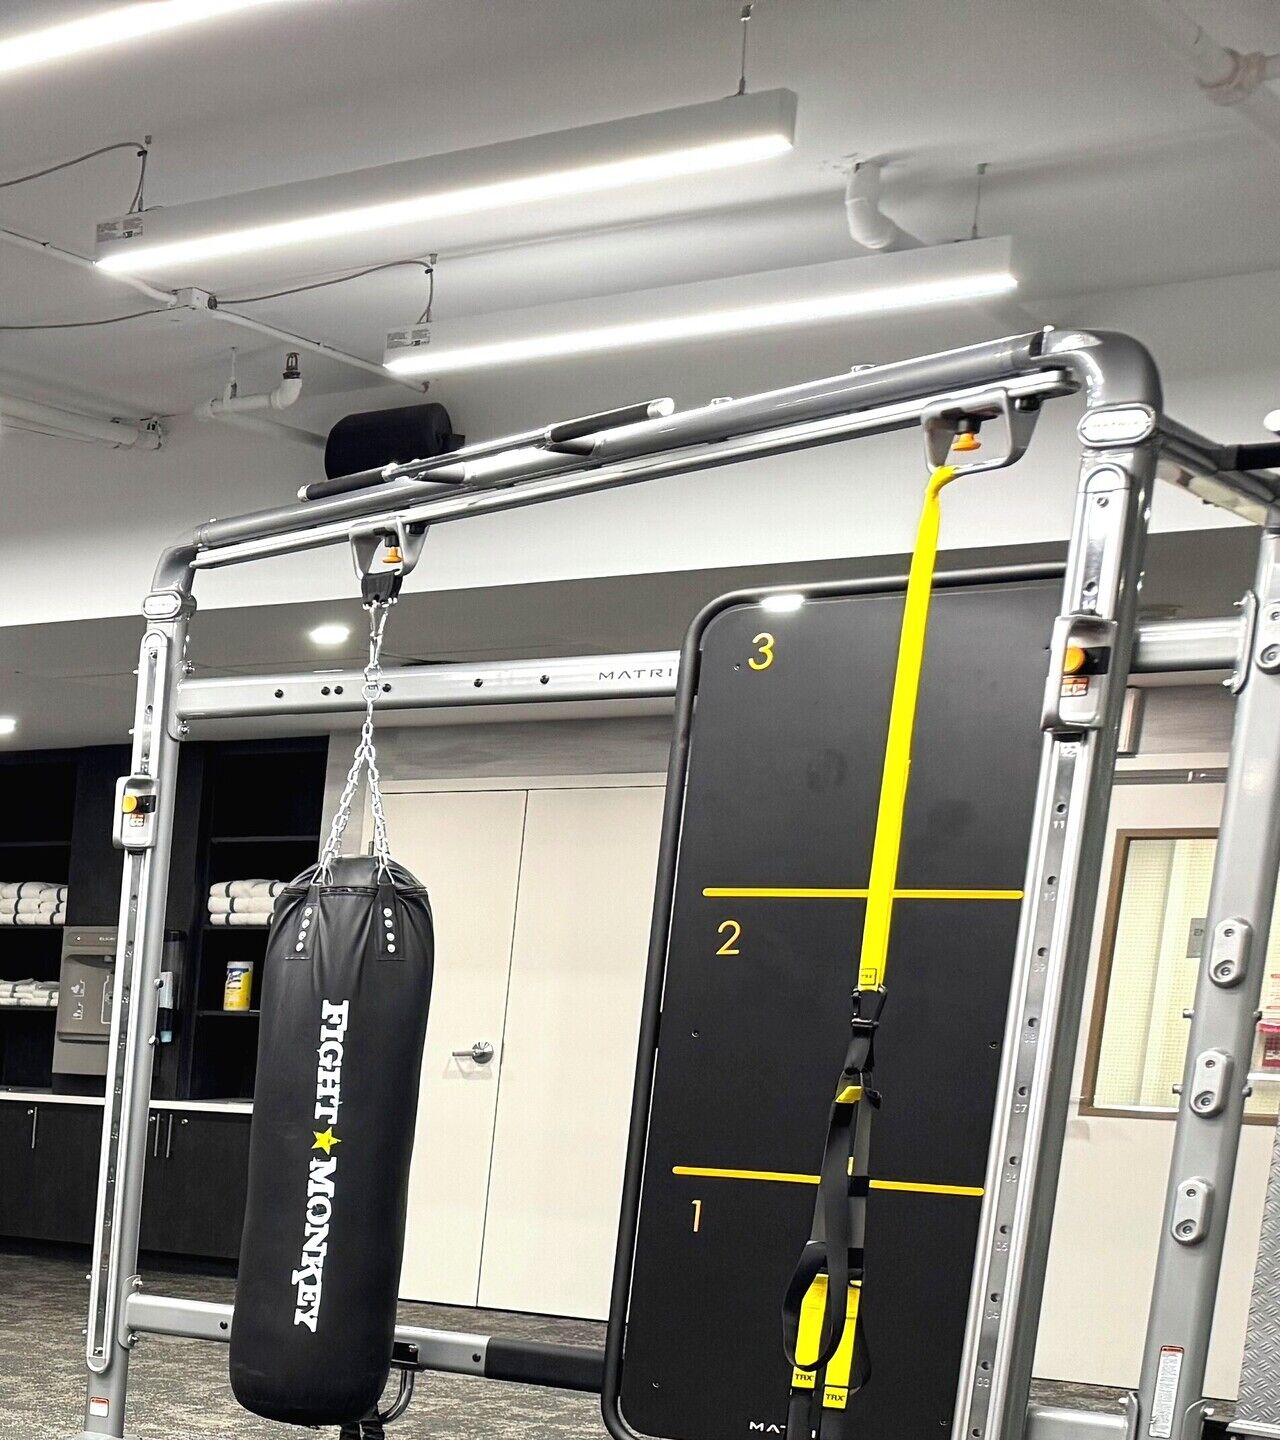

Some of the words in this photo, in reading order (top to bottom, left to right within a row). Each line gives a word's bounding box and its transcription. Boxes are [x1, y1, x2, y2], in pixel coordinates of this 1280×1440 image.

[747, 631, 775, 672] 3
[597, 668, 673, 681] MATRI
[714, 919, 742, 956] 2
[313, 999, 350, 1125] FIGHT
[690, 1199, 701, 1233] 1
[291, 1155, 338, 1333] MONKEY
[794, 1373, 814, 1382] TRX
[825, 1392, 845, 1402] TRX
